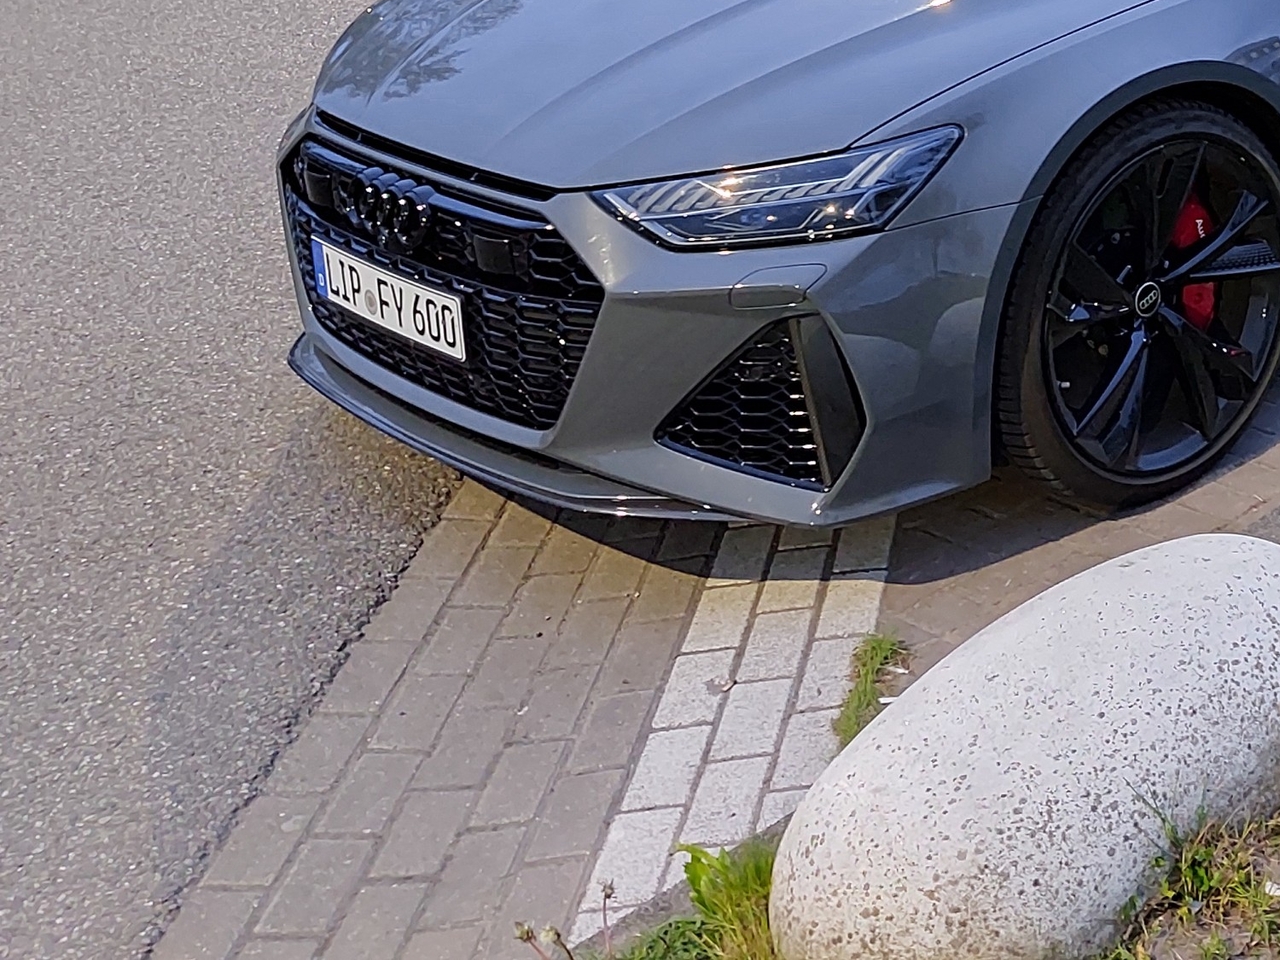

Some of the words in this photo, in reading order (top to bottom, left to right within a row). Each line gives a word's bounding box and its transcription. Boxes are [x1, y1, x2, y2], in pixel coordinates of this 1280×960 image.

[326, 252, 362, 307] LIP
[377, 277, 403, 328] FY
[412, 293, 457, 349] 600
